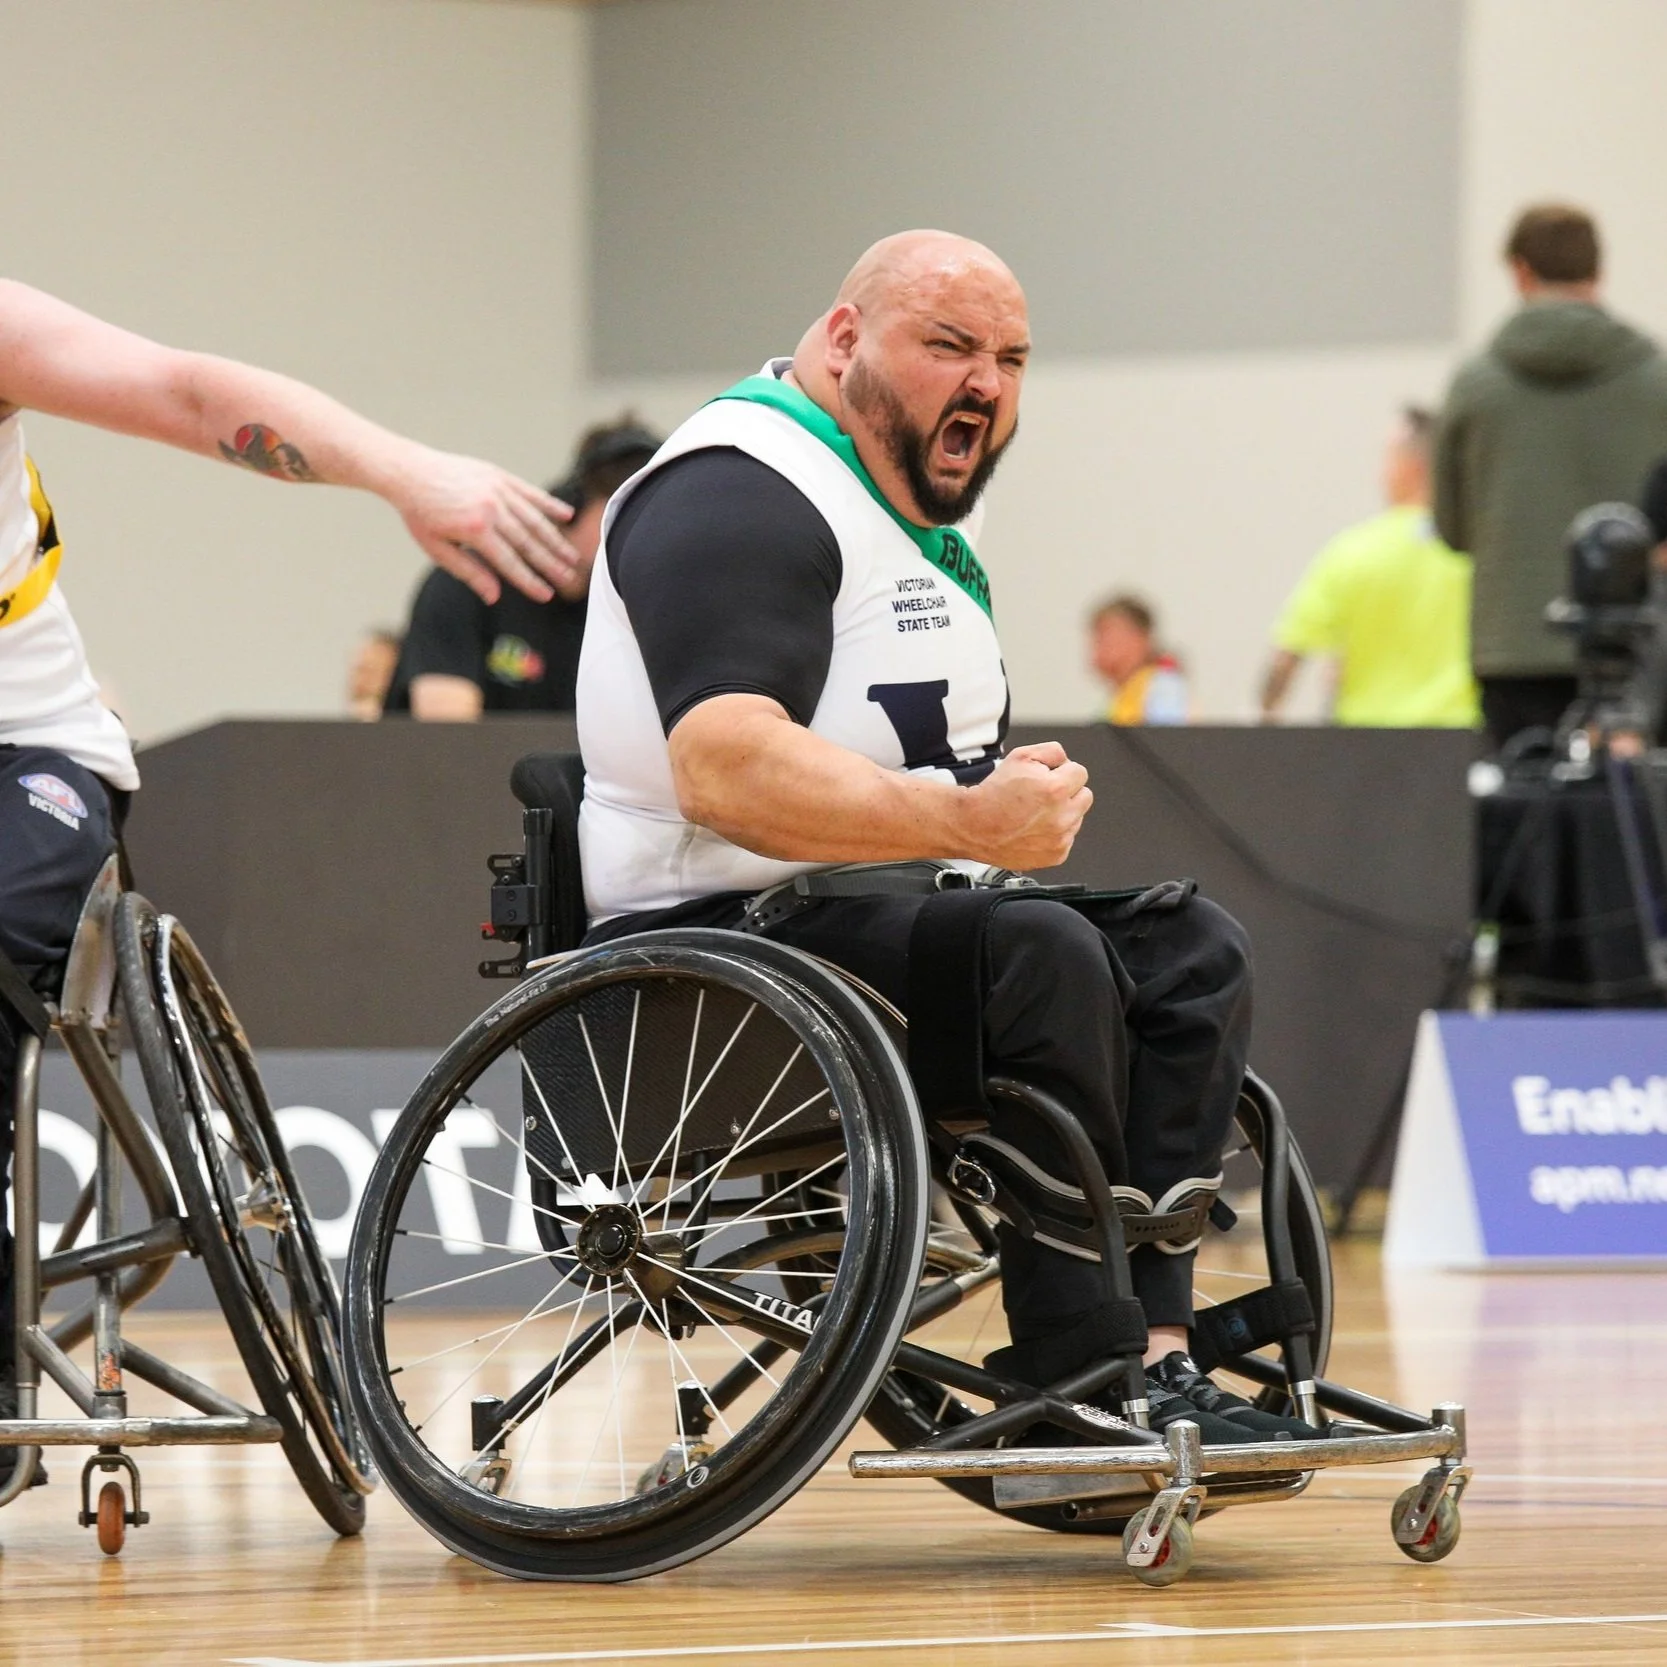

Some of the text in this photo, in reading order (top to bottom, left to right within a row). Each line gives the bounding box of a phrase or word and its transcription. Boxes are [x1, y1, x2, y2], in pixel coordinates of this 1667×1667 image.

[894, 578, 936, 593] VICTORIAN
[891, 596, 947, 613] WHEELCHAIR
[897, 614, 951, 633] STATE TEAM
[28, 792, 80, 831] VICTORIA
[1513, 1076, 1667, 1135] Enabl
[754, 1292, 821, 1334] TITA
